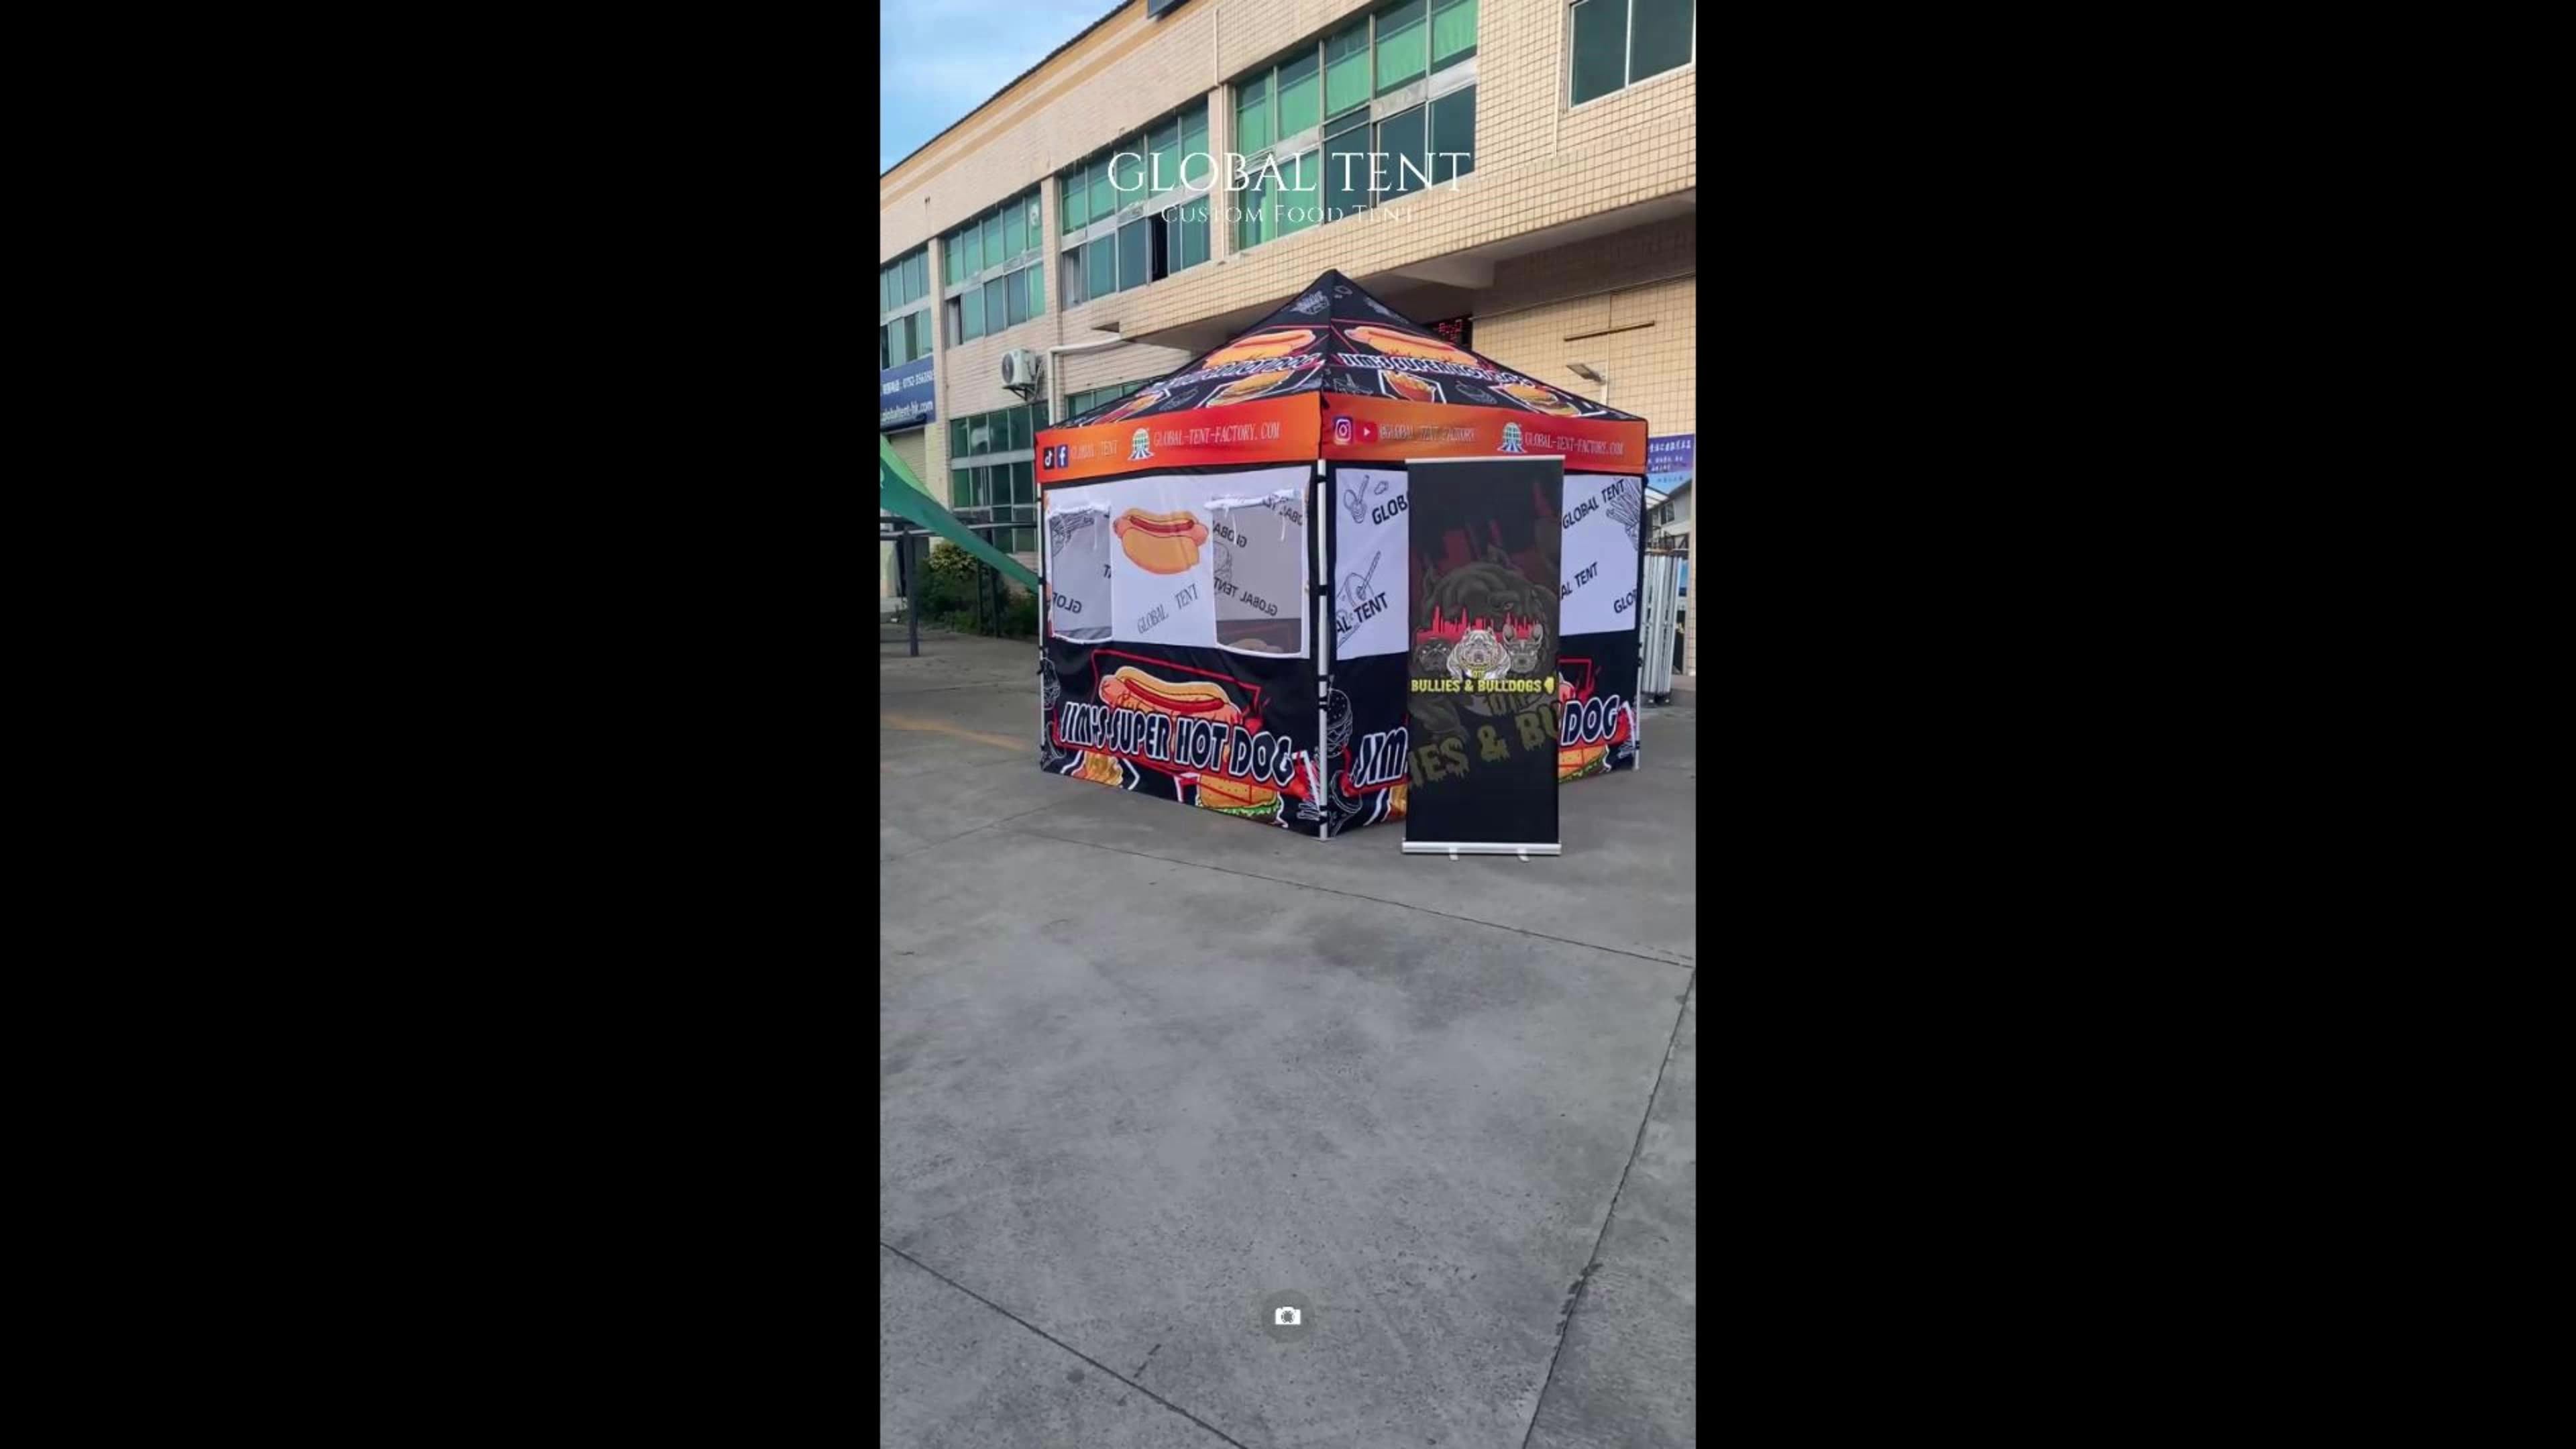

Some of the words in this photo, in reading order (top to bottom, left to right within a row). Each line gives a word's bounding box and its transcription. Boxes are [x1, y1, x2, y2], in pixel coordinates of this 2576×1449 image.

[1372, 490, 1408, 525] GLOB
[1562, 496, 1599, 529] GLOBAL
[1601, 478, 1625, 503] TENT
[1574, 561, 1598, 588] TENT
[1137, 604, 1169, 634] GLOBAL
[1175, 583, 1199, 610] TENT
[1354, 592, 1388, 623] TENT
[1411, 679, 1460, 692] BULLIES
[1464, 679, 1474, 692] &
[1478, 679, 1542, 693] BULLDOGS
[1561, 694, 1619, 747] DOG
[1109, 708, 1172, 761] SUPER
[1175, 717, 1228, 771] HOT
[1228, 725, 1295, 786] DOG
